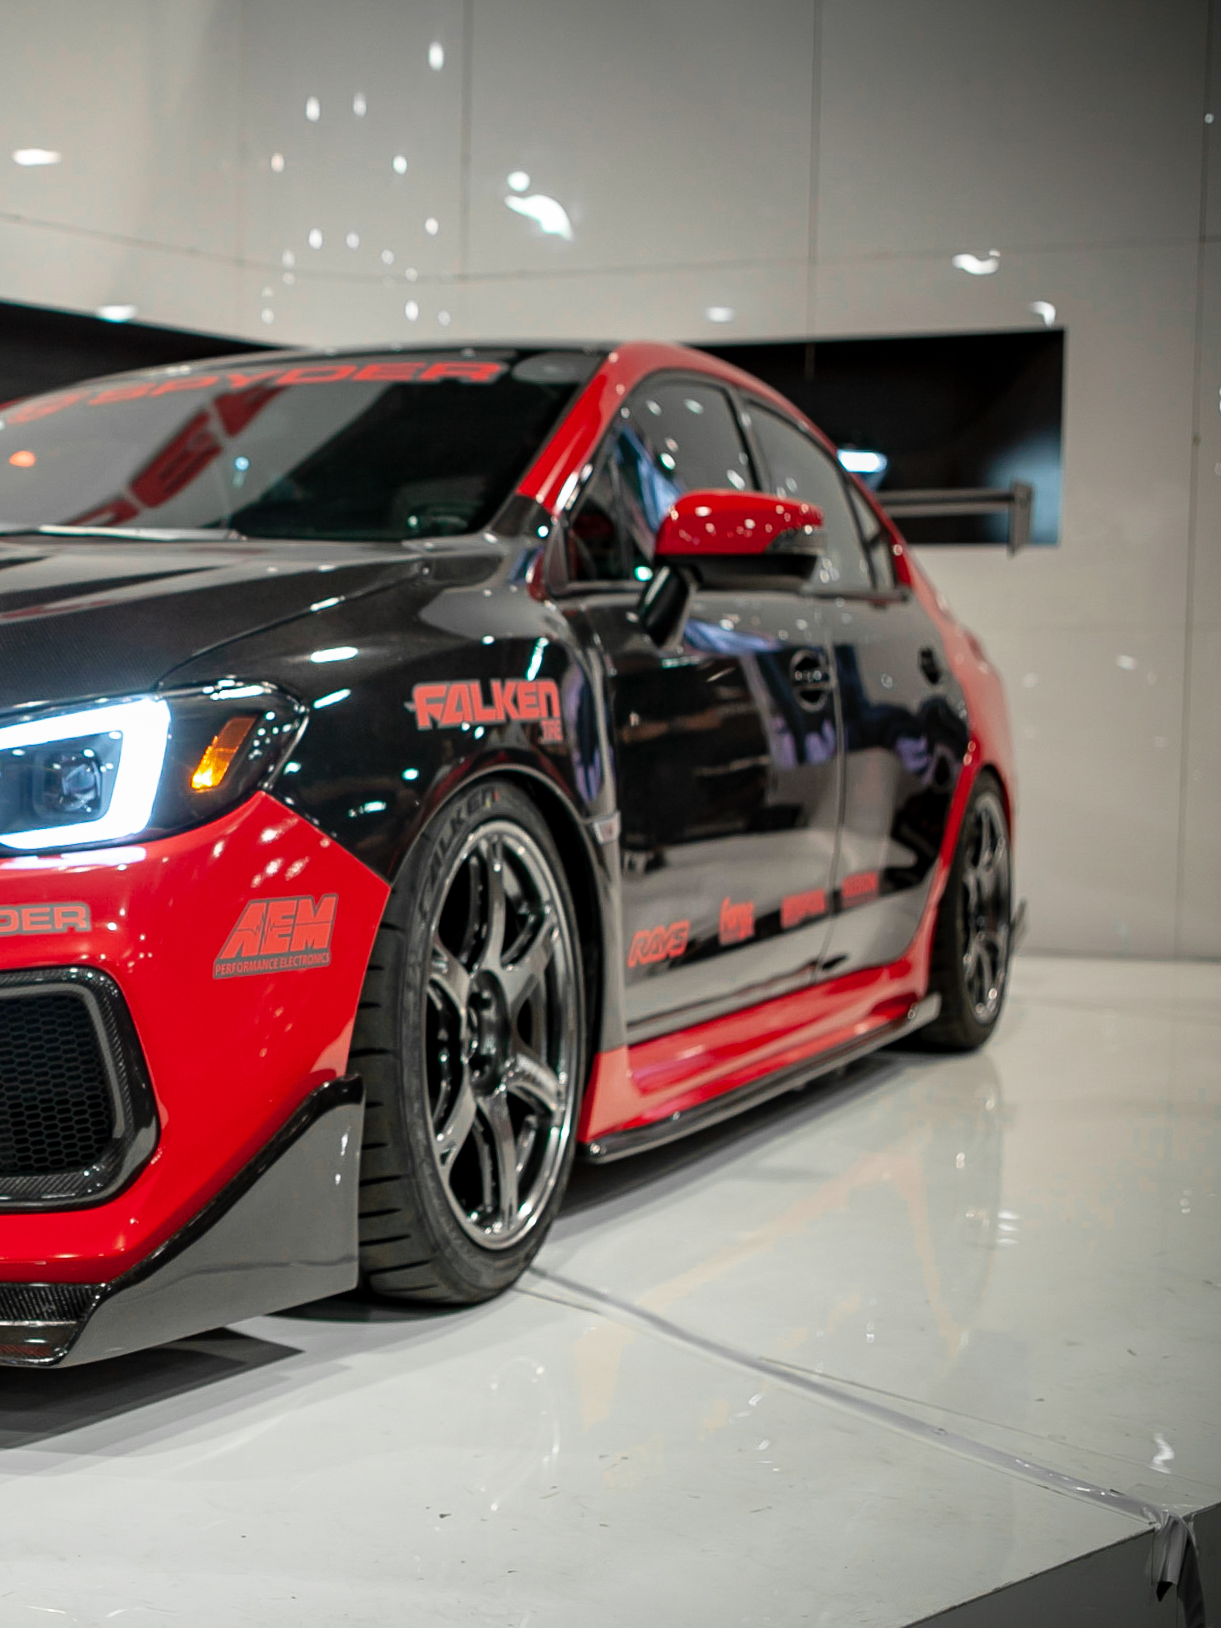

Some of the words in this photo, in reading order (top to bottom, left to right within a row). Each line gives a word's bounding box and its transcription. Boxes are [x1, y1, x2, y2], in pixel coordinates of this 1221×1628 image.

[88, 361, 505, 406] SPYDER
[413, 679, 561, 728] FALKEN
[220, 896, 337, 959] AEM
[215, 957, 278, 975] PERFORMANCE
[279, 952, 331, 969] ELECTRONICS
